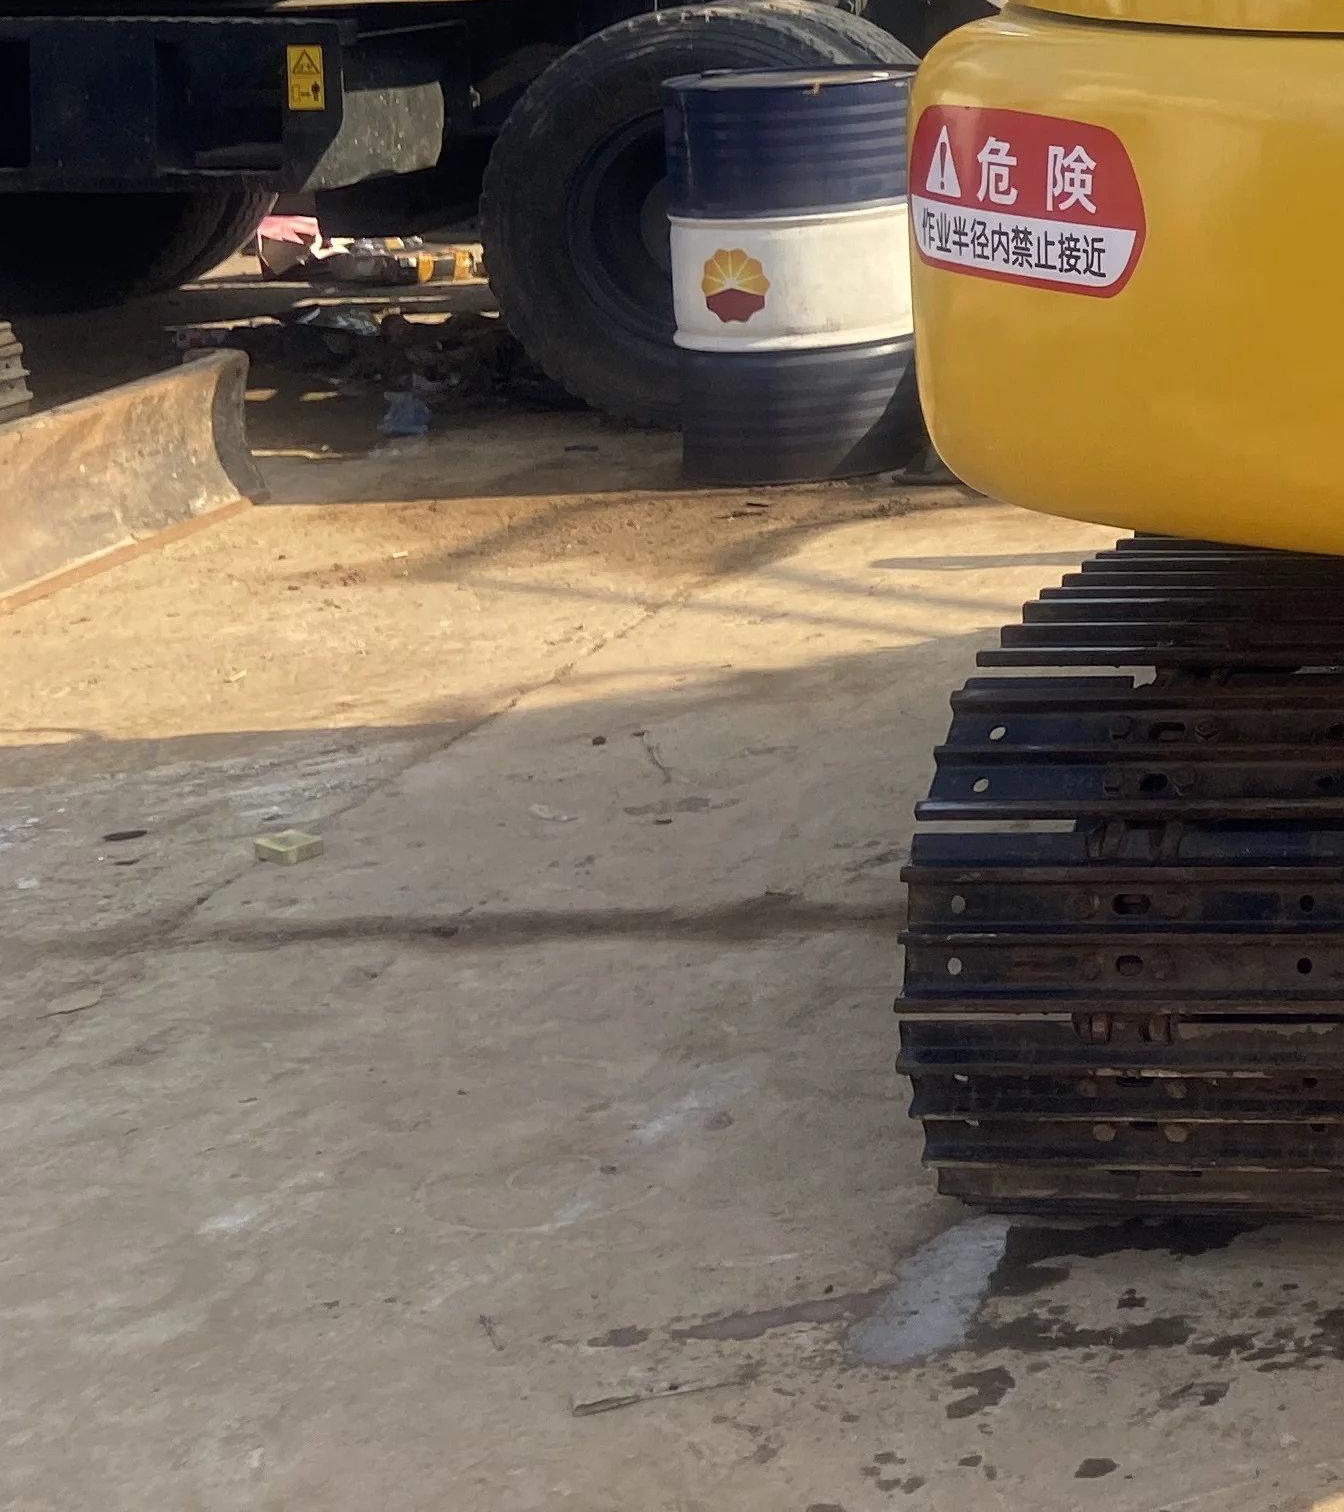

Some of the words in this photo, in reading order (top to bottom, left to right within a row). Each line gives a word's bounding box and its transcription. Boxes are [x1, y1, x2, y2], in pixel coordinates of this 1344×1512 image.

[921, 207, 1107, 278] 作业半径内禁止接近
